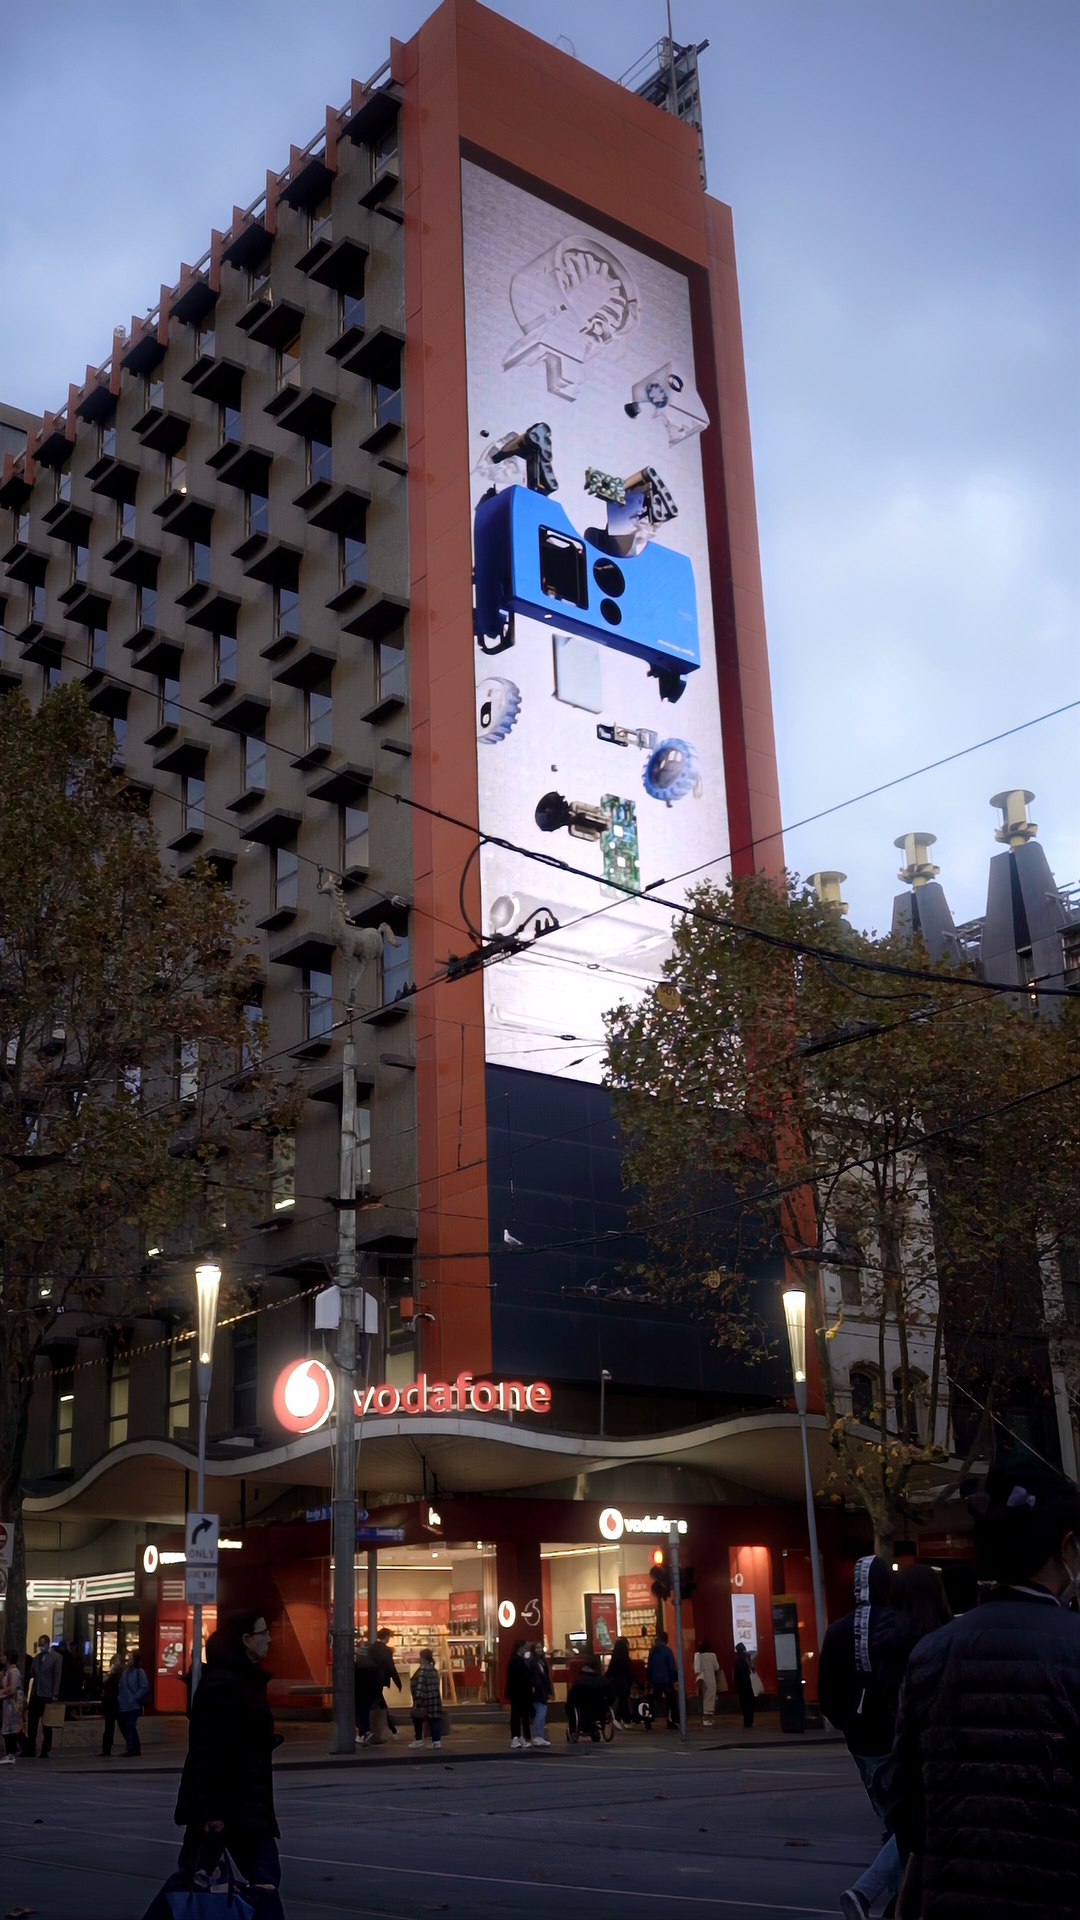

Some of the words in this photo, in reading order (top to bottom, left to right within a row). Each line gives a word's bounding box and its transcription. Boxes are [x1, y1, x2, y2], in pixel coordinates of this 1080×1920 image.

[353, 1371, 552, 1416] vodafone
[624, 1515, 687, 1534] vodafoe
[188, 1549, 215, 1559] ONLY
